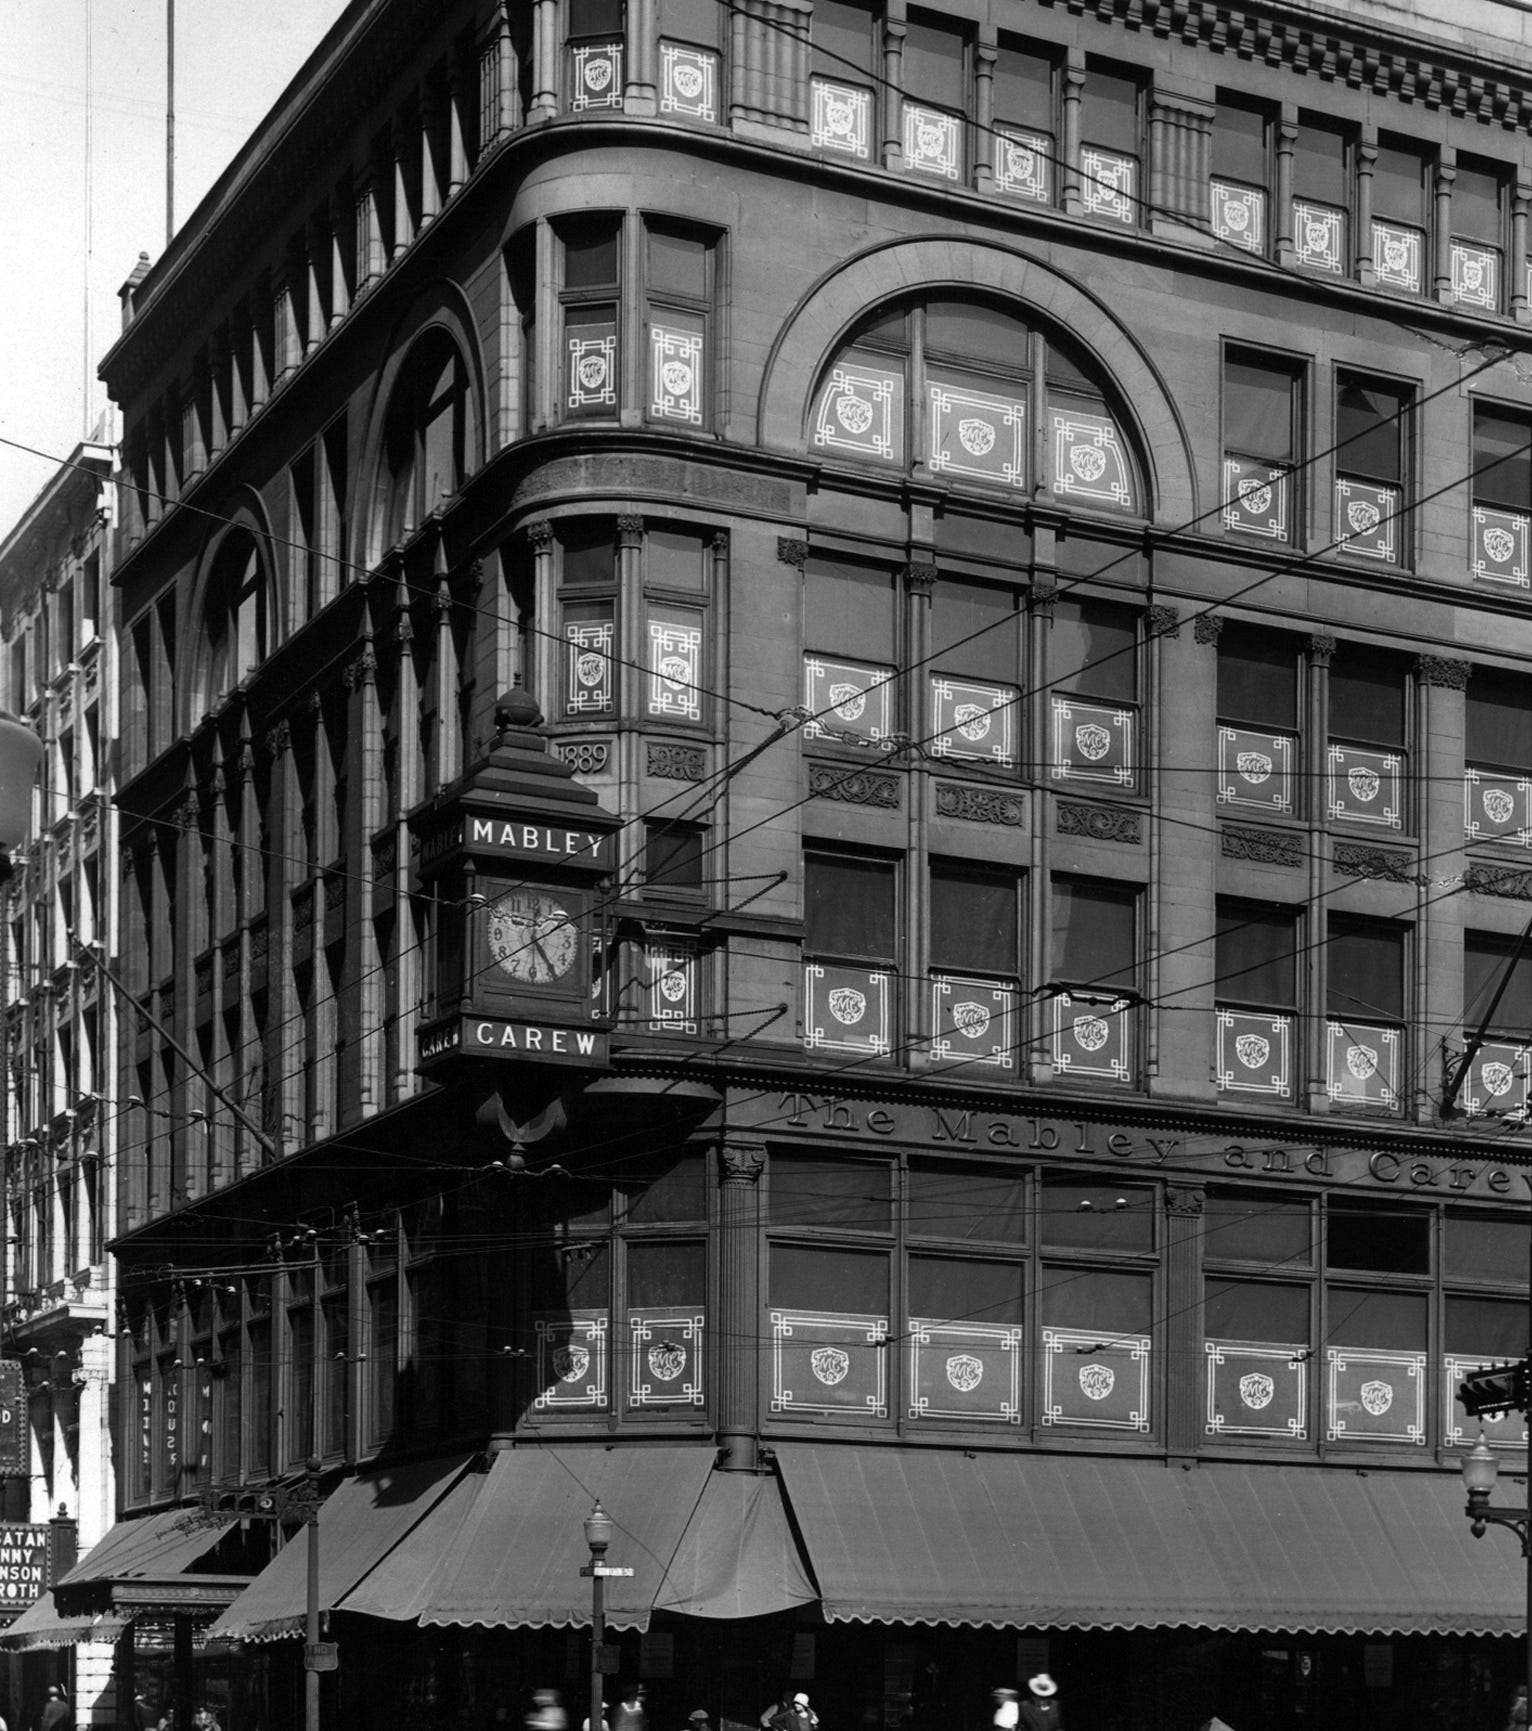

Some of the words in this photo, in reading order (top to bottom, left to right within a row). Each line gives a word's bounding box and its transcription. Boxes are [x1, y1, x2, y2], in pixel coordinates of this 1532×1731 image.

[474, 820, 602, 857] MABLEY
[477, 1023, 595, 1055] CAREW
[779, 1091, 896, 1135] The
[931, 1107, 1179, 1164] Mabley
[1224, 1144, 1334, 1177] and
[0, 1531, 46, 1547] ATAN
